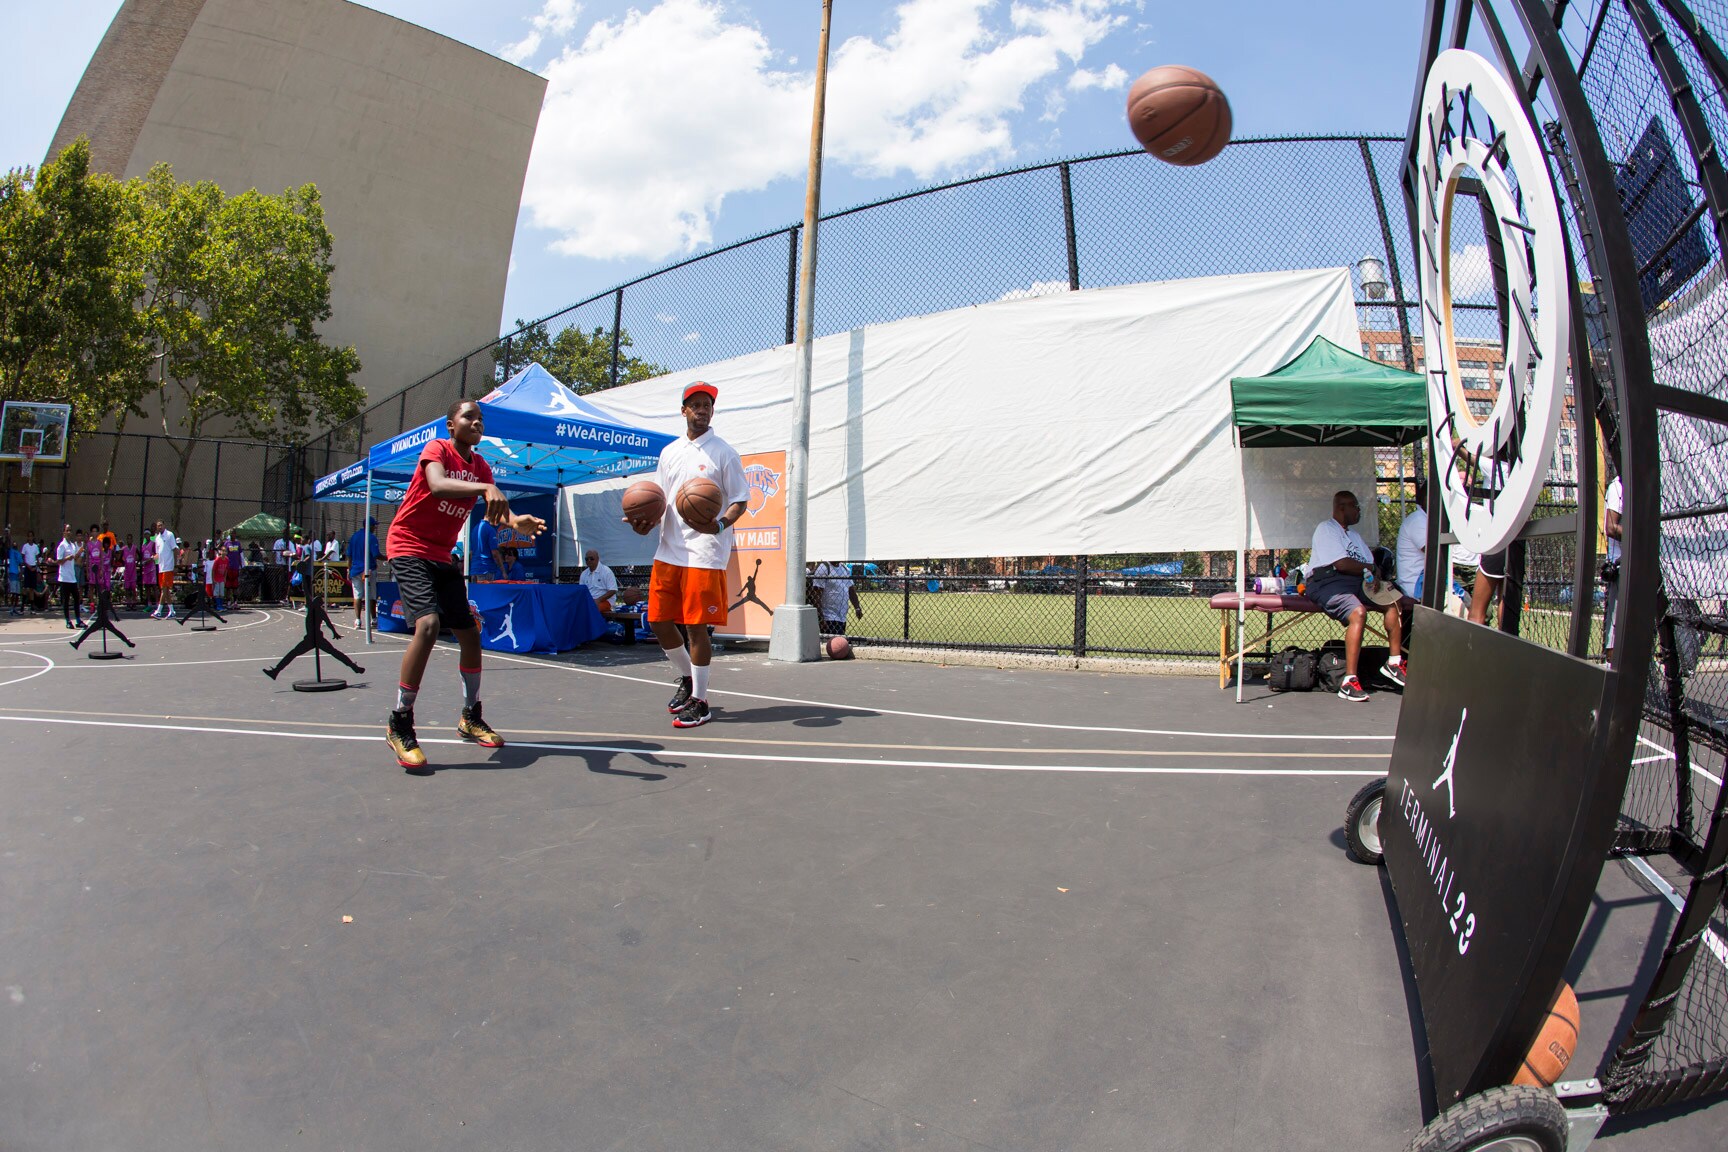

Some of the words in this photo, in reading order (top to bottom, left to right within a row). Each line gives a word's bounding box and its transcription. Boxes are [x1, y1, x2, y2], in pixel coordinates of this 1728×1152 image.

[390, 426, 437, 455] NYKNICKS.COM
[555, 423, 649, 448] #WeAreJordan
[747, 531, 778, 546] MADE
[1400, 778, 1455, 913] TERMINAL
[1449, 891, 1476, 955] 23
